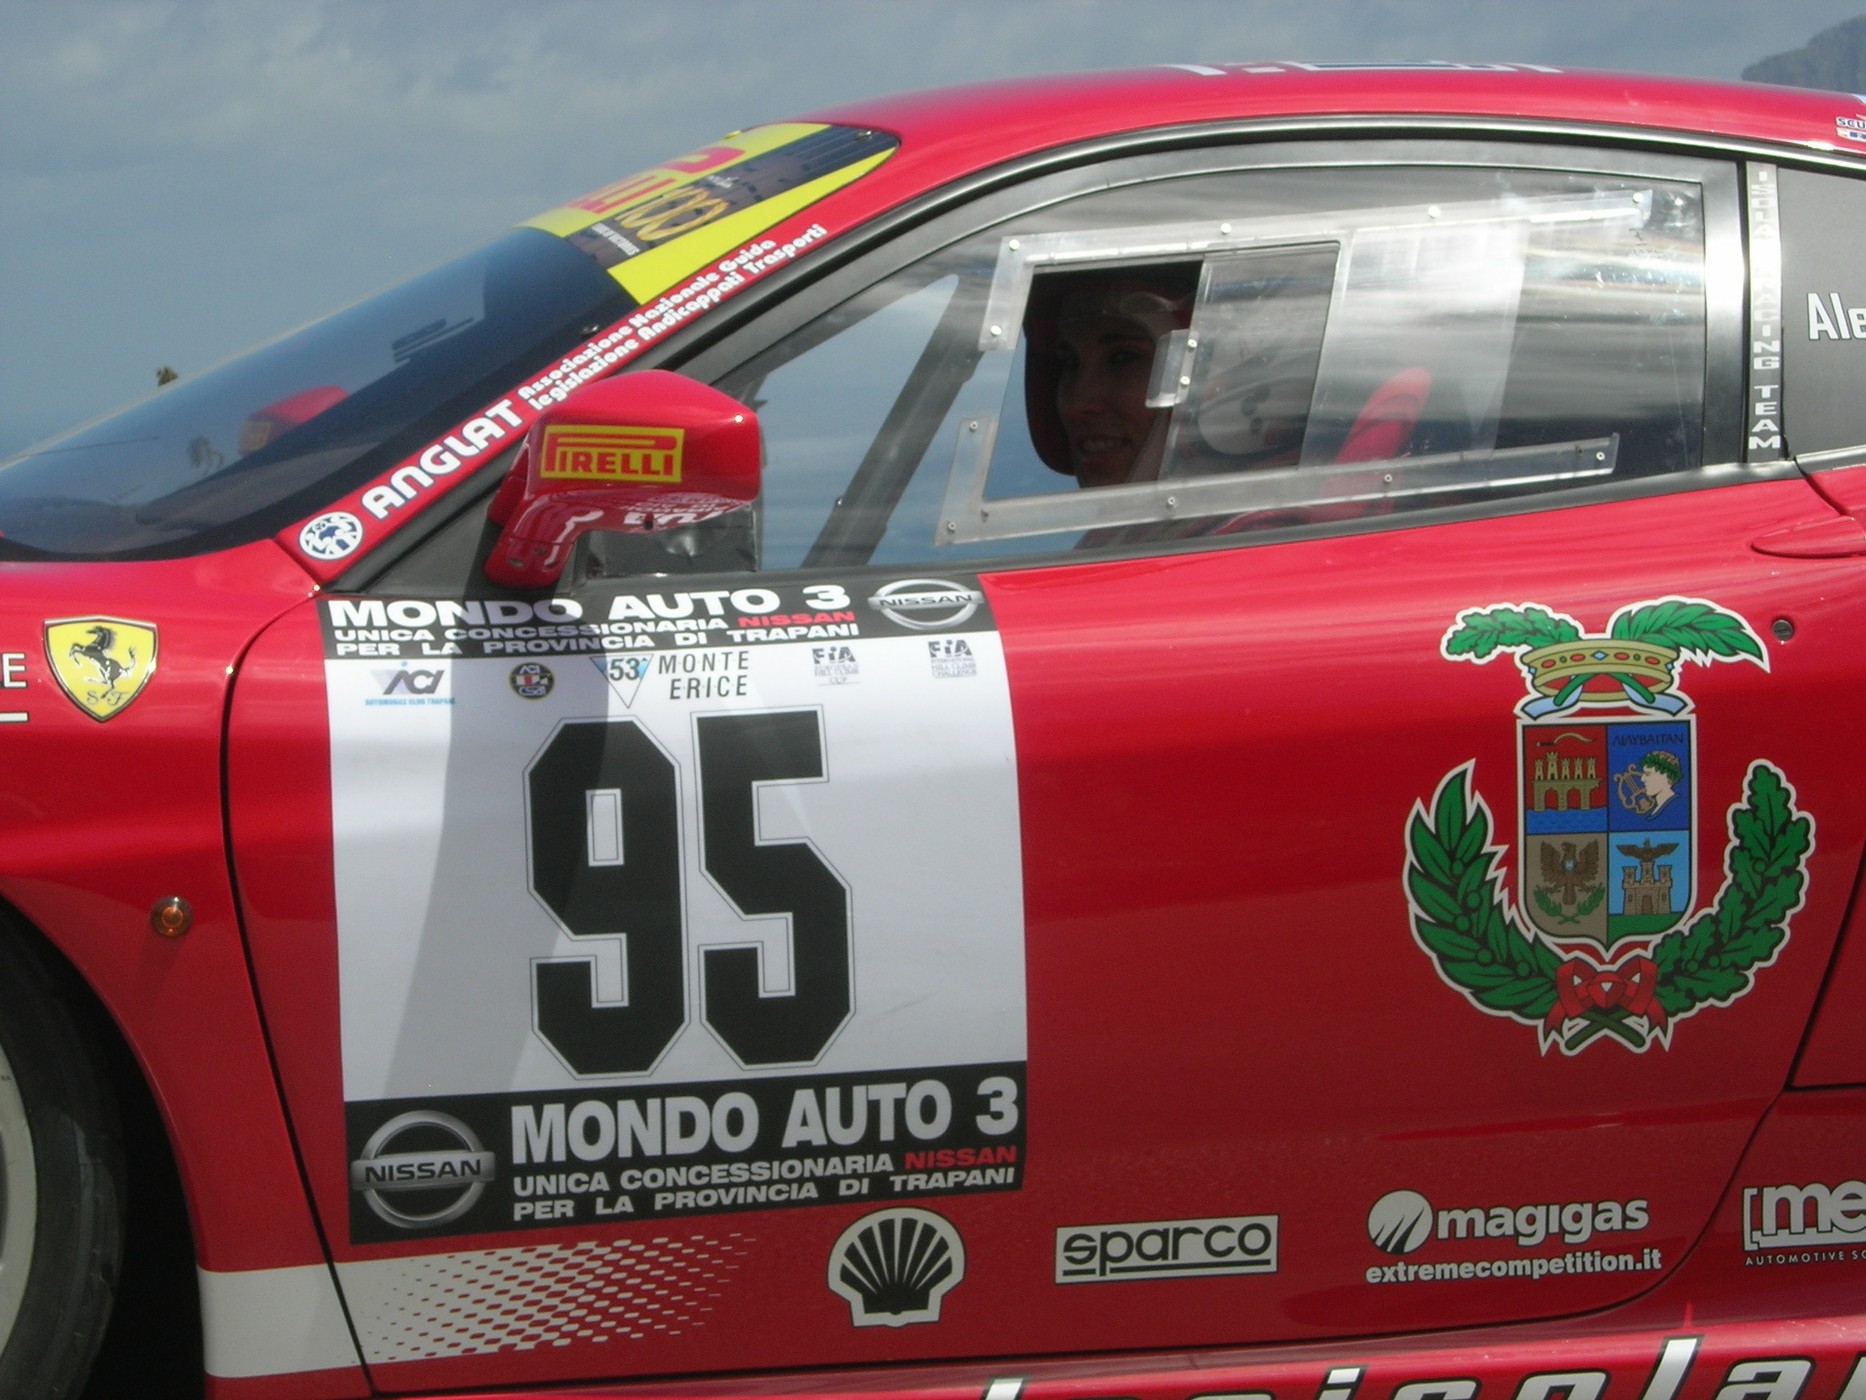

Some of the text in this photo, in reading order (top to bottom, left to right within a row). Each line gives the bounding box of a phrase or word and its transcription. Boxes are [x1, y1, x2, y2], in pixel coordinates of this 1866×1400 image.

[518, 240, 776, 400] Associazione Nazionale Guida
[528, 223, 828, 410] legislazione Andicappati Trasporti
[1807, 292, 1866, 340] Ale
[1748, 385, 1781, 449] TEAM
[361, 398, 523, 519] ANGLAT
[545, 431, 677, 477] PIRELLI
[328, 584, 851, 628] MONDO AUTO 3
[879, 593, 974, 607] NISSAN
[334, 610, 855, 642] UNICA CONCESSIONARIA NISSAN
[336, 623, 859, 656] PER LA PROVINCIA DI TRAPANI
[658, 650, 749, 675] MONTE
[670, 675, 748, 700] ERICE
[526, 707, 854, 1078] 95
[511, 1076, 1019, 1165] MONDO AUTO 3
[365, 1158, 481, 1183] NISSAN
[513, 1145, 1017, 1198] UNICA CONCESSIONARIA NISSAN
[513, 1168, 1015, 1222] PER LA PROVINCIA DI TRAPANI
[1437, 1197, 1649, 1247] magigas
[1063, 1222, 1272, 1277] sparco
[1366, 1247, 1662, 1284] extremecompetition.it
[1745, 1251, 1845, 1266] AUTOMOTIVE
